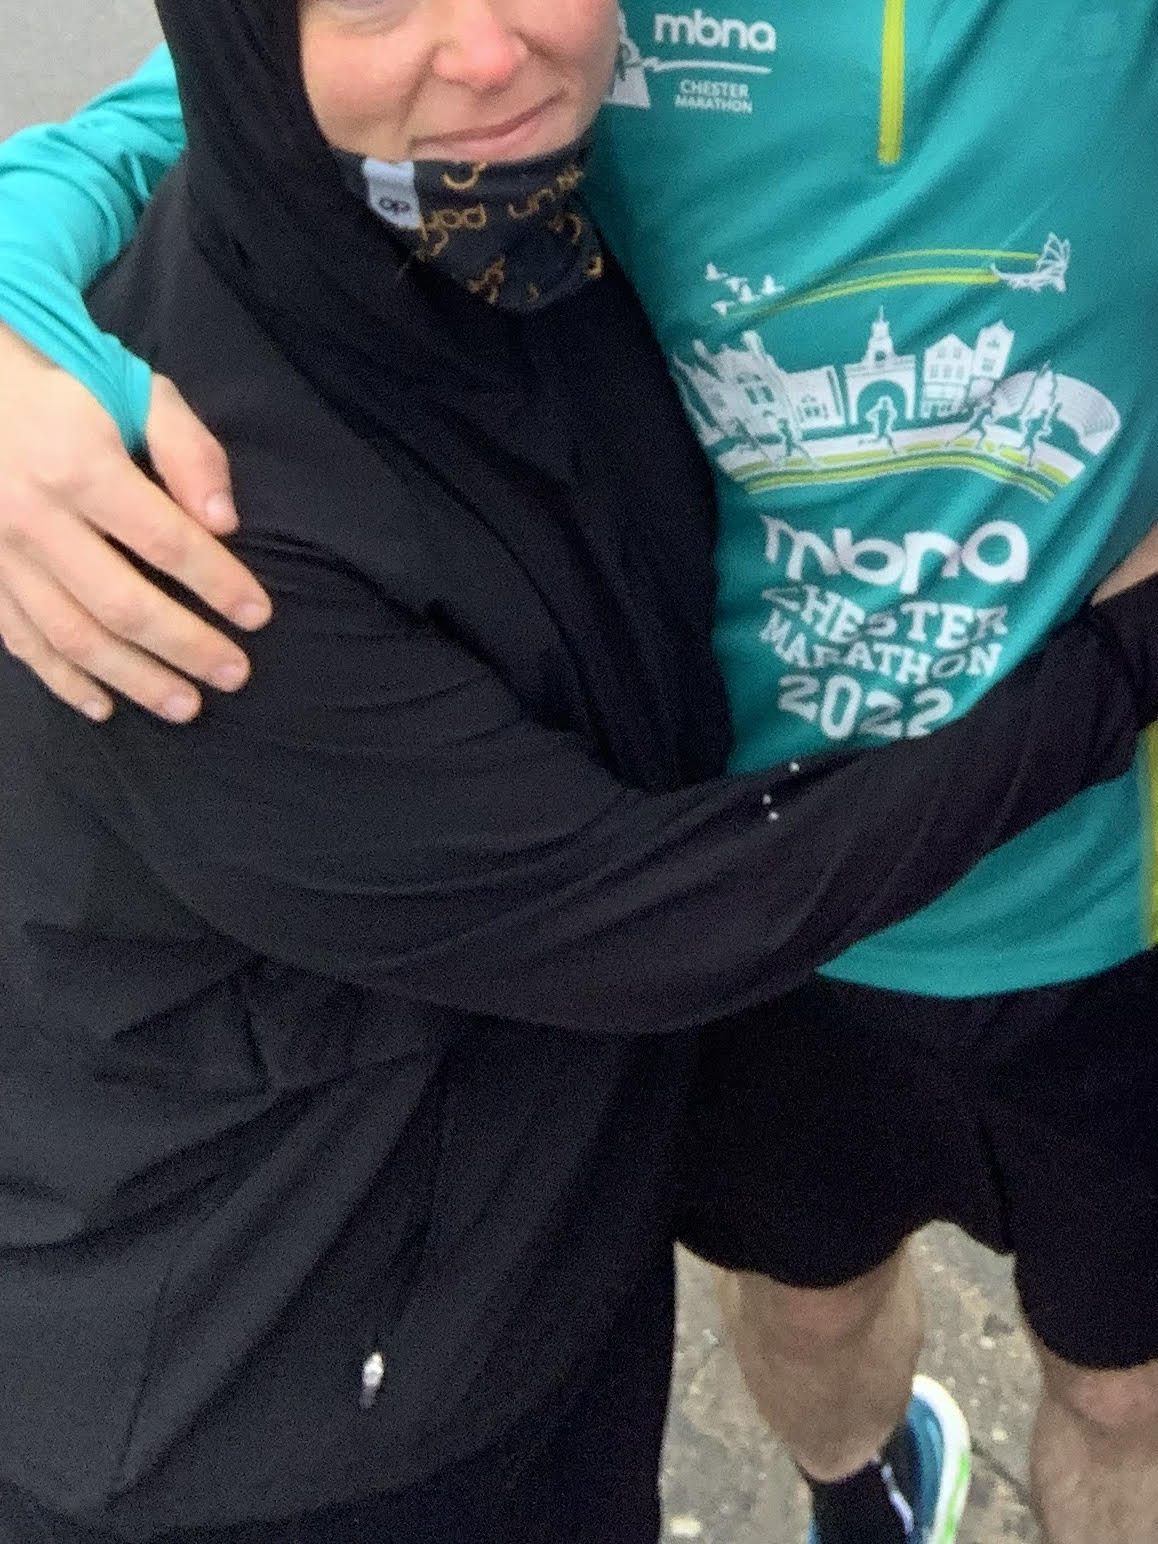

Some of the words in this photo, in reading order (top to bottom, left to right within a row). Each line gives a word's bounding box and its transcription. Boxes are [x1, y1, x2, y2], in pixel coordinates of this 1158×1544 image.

[654, 8, 777, 52] mbna
[679, 79, 749, 98] CHESTER
[760, 513, 1029, 594] mbna
[777, 673, 954, 741] 2022
